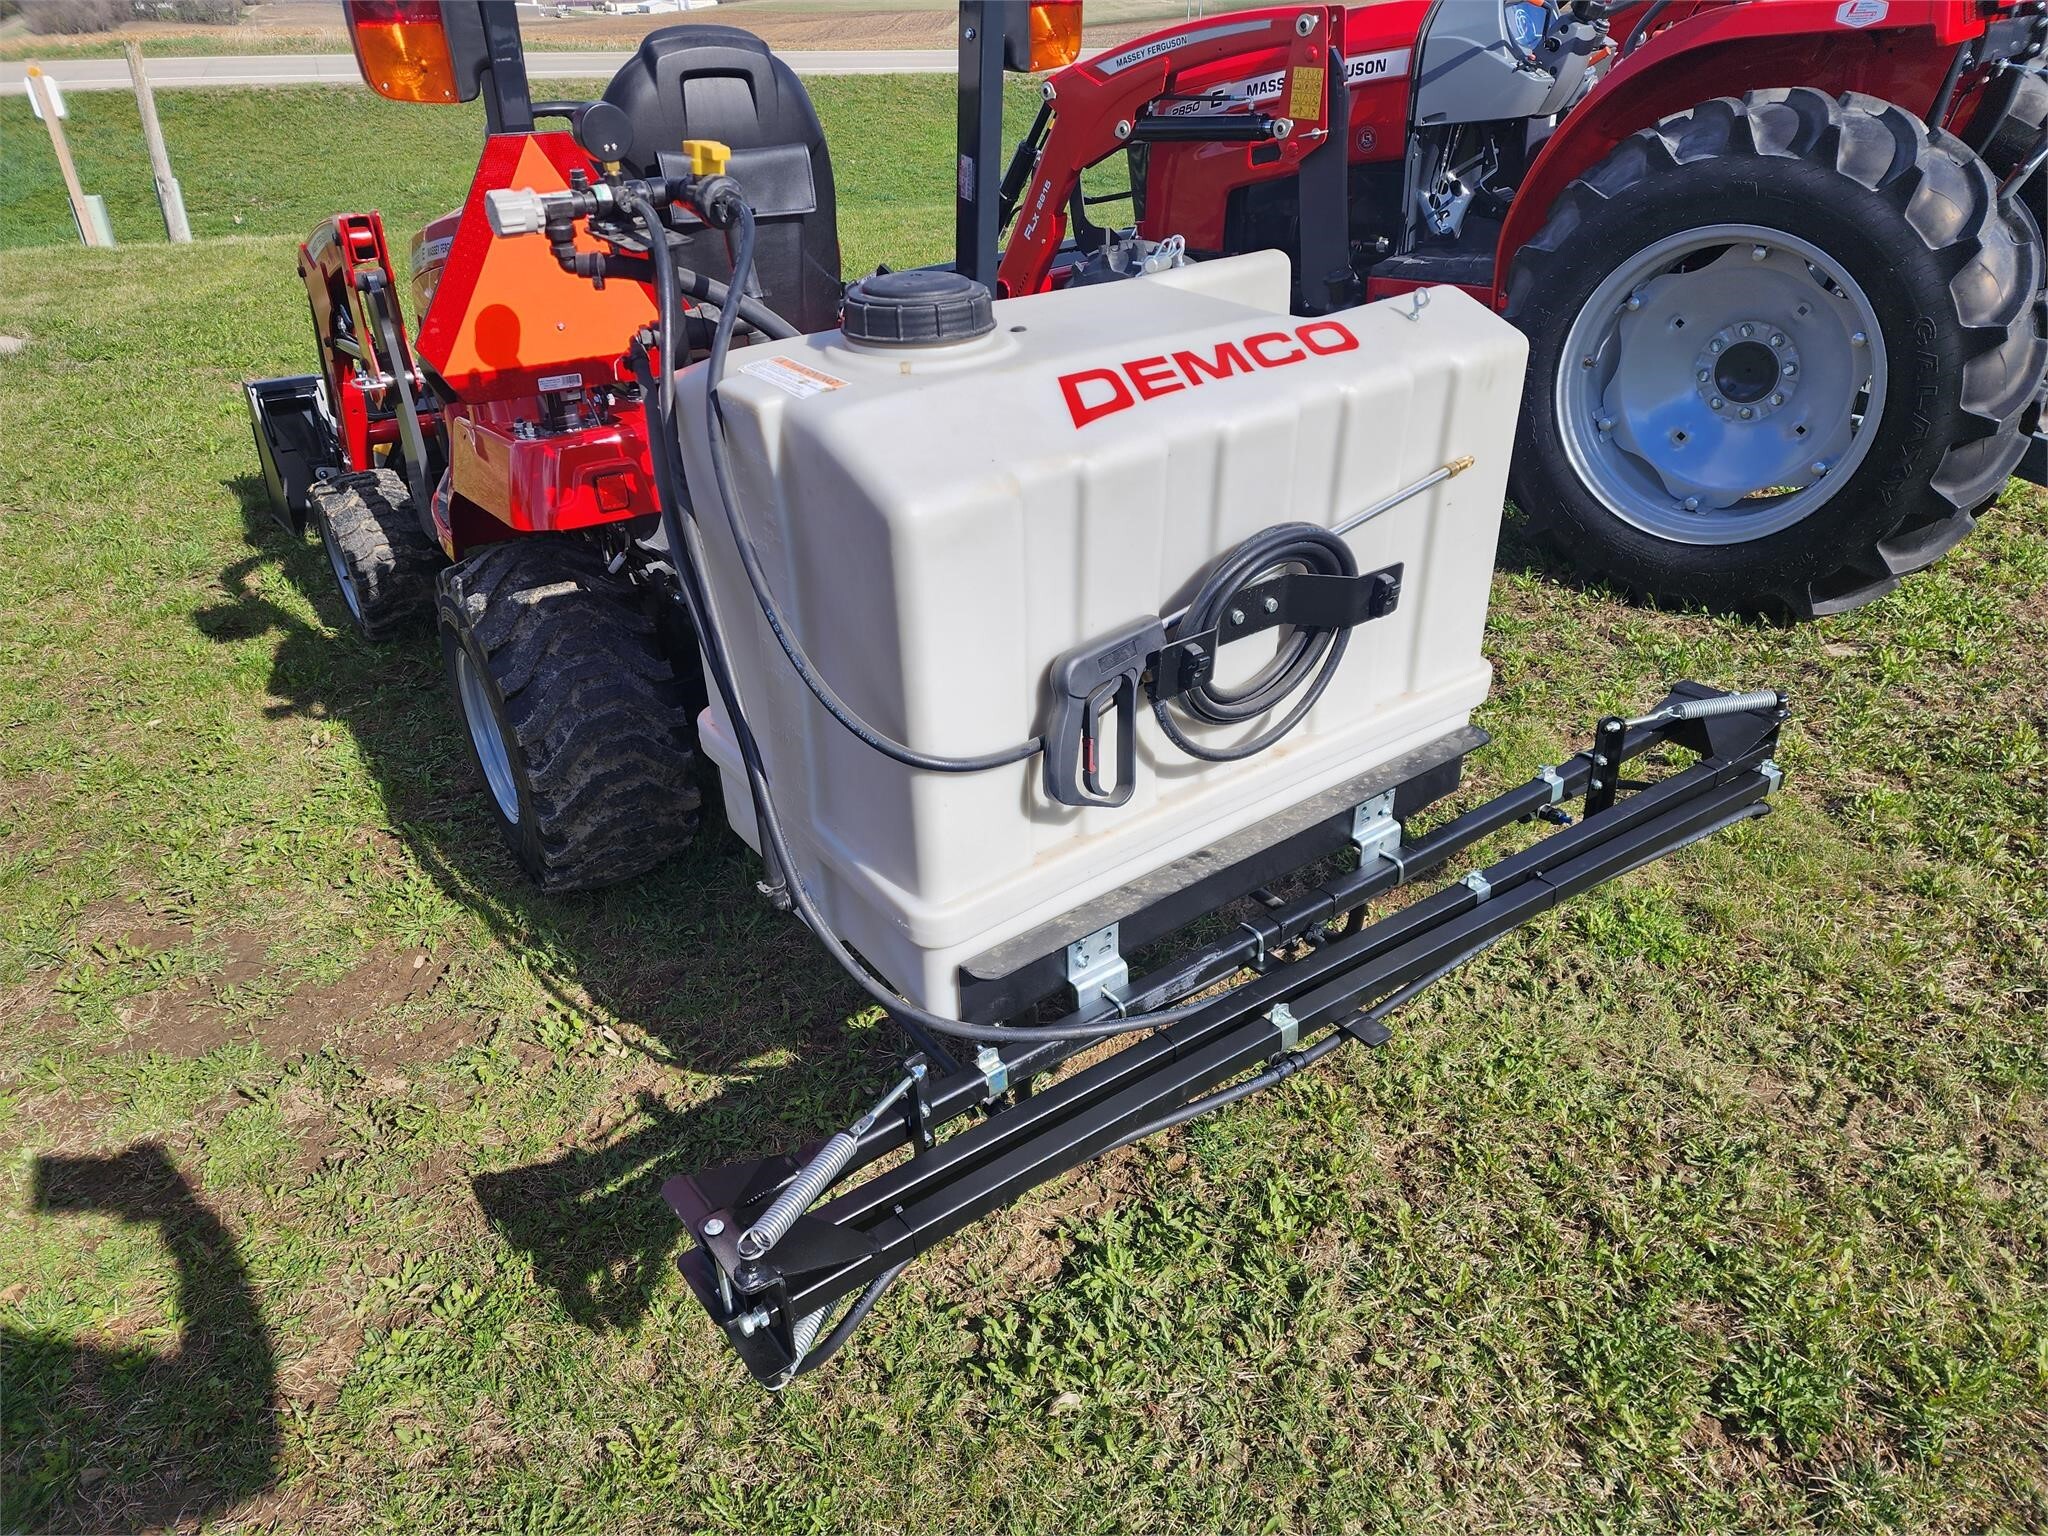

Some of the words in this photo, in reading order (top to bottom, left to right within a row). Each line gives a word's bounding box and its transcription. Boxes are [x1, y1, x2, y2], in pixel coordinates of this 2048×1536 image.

[1115, 49, 1145, 68] MASSEY
[1147, 36, 1188, 56] FERGUSON
[1172, 101, 1200, 116] 2850
[1246, 77, 1285, 97] MASS
[1345, 58, 1387, 78] USON
[1057, 320, 1360, 430] DEMCO
